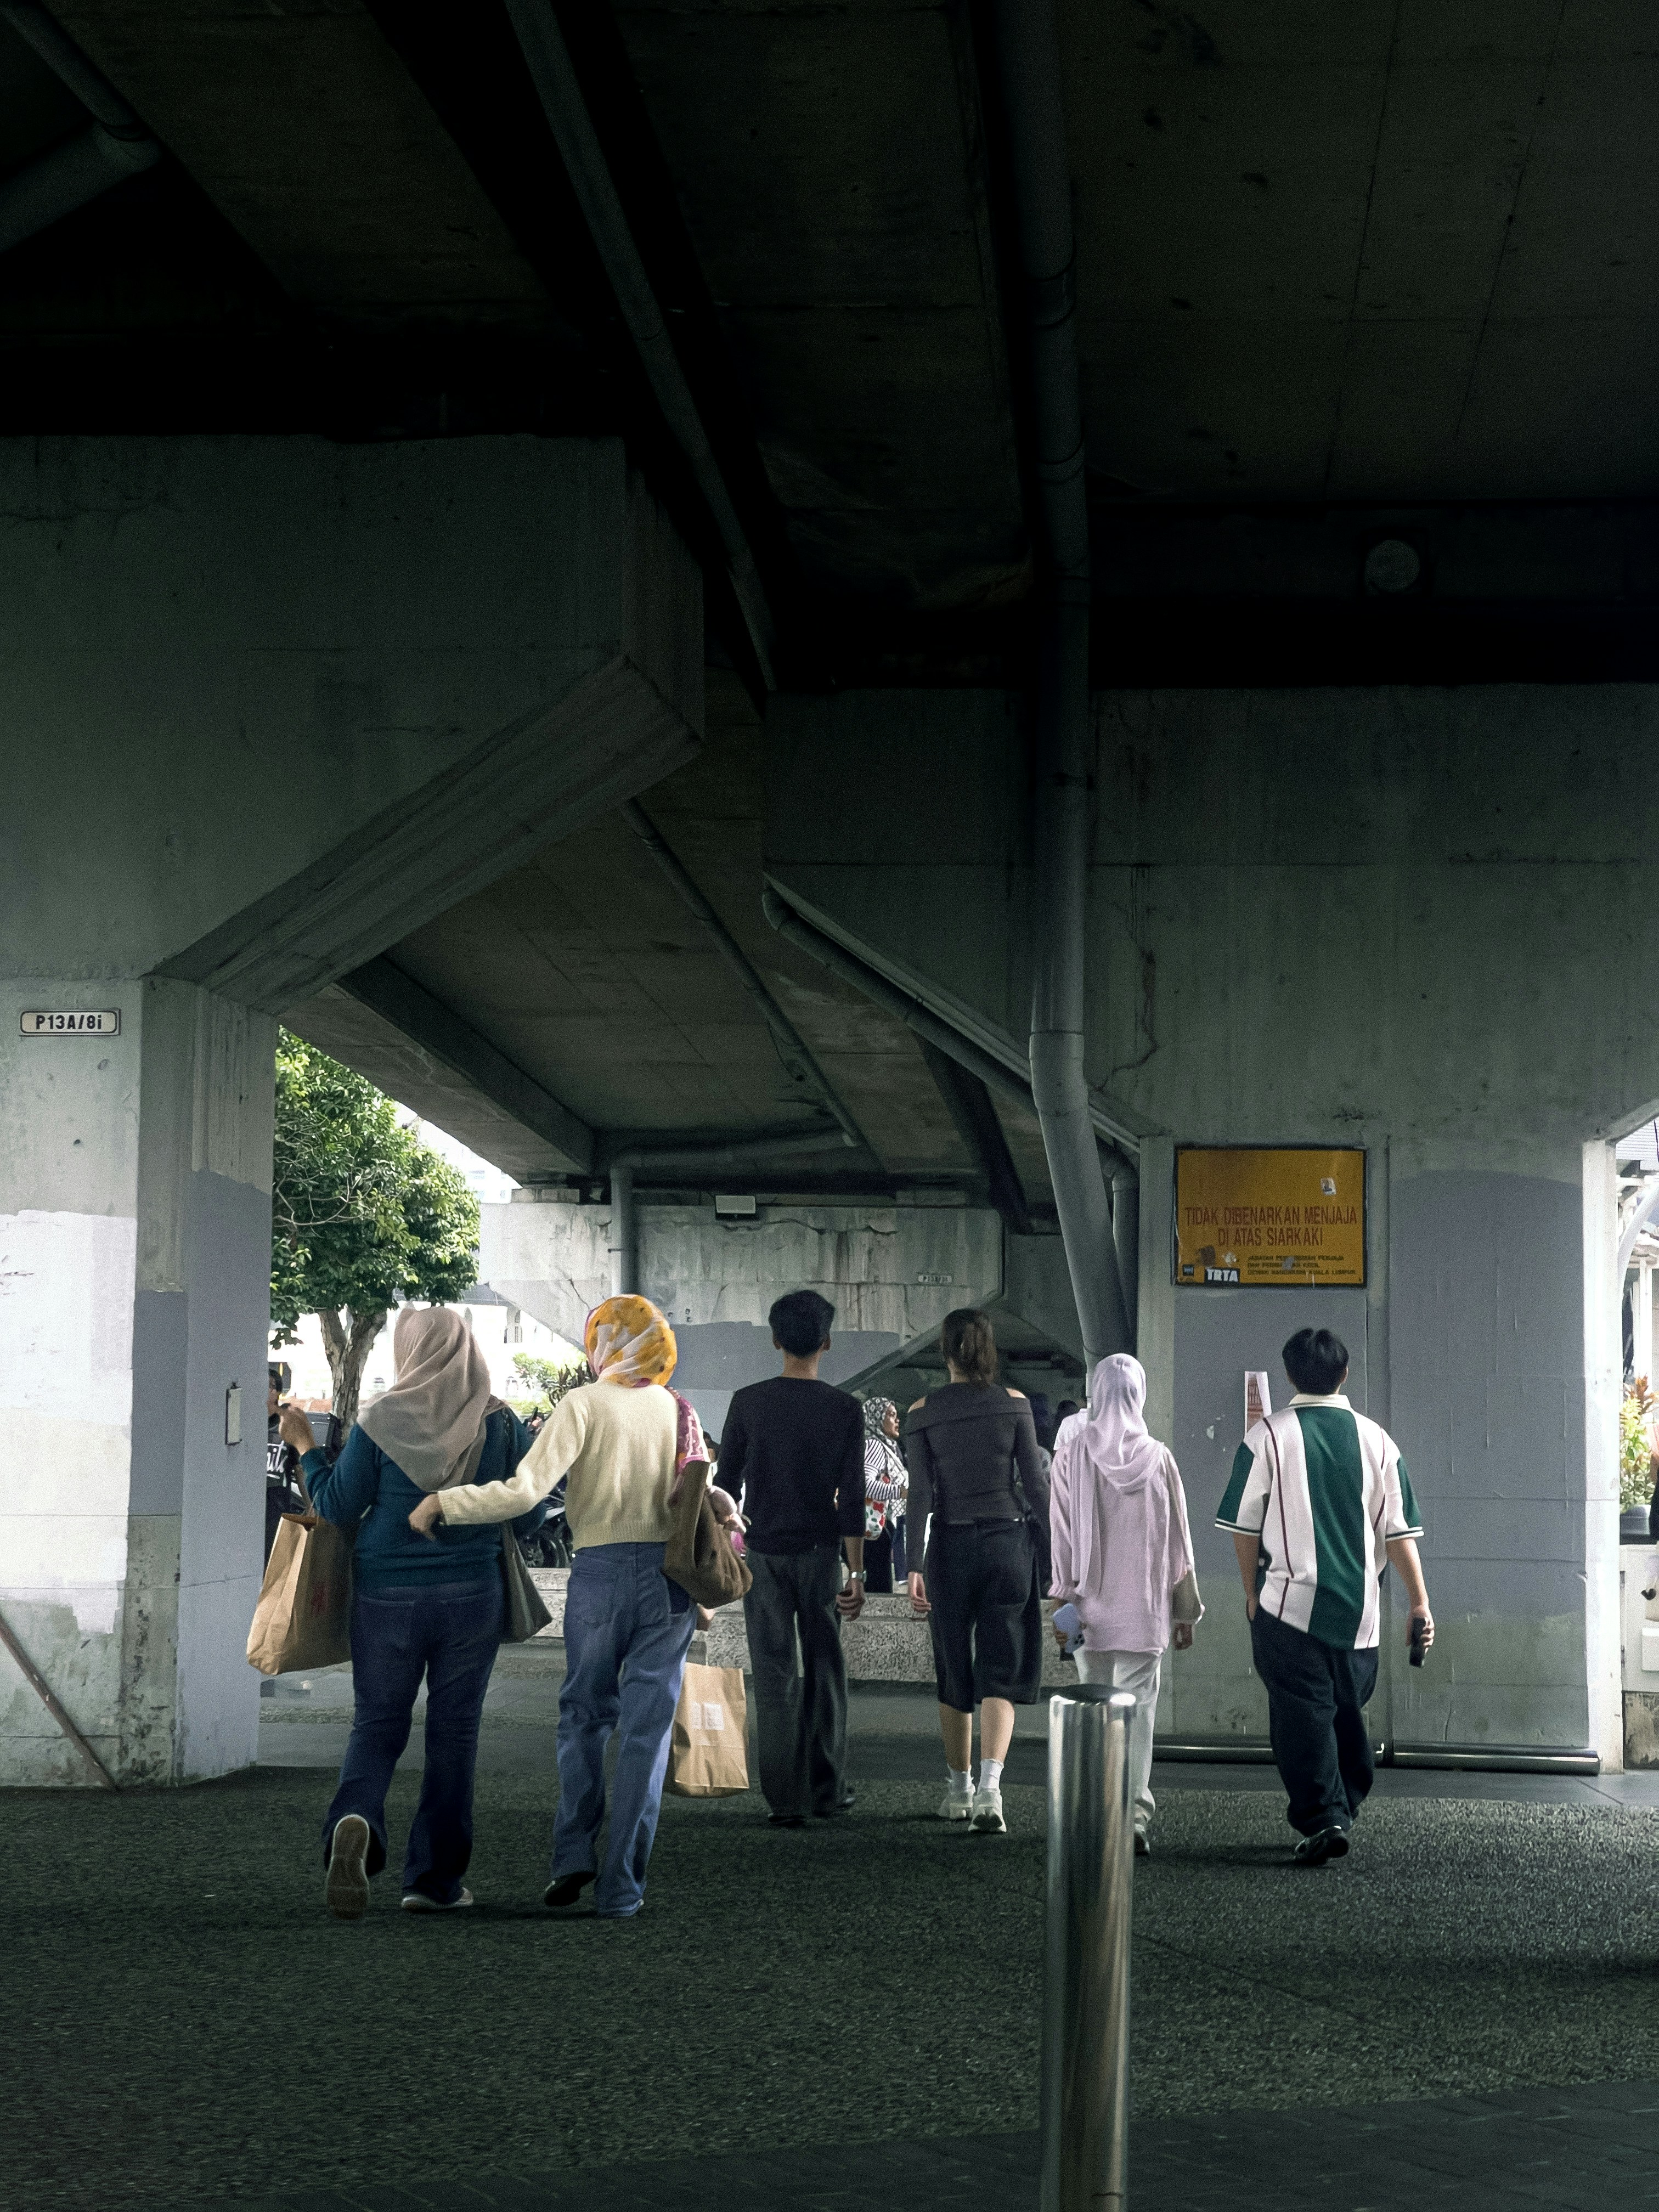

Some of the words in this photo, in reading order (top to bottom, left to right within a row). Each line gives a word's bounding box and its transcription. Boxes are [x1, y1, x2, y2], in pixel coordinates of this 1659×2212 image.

[36, 1014, 102, 1030] P13A/8i
[1184, 1207, 1218, 1226] TIDAK
[1224, 1206, 1300, 1226] DIBENARKAN
[1305, 1206, 1357, 1224] MENJAJA
[1218, 1228, 1229, 1246] DI
[1234, 1228, 1262, 1246] ATAS
[1266, 1227, 1323, 1246] SIARKAKI
[1206, 1268, 1238, 1282] TRTA
